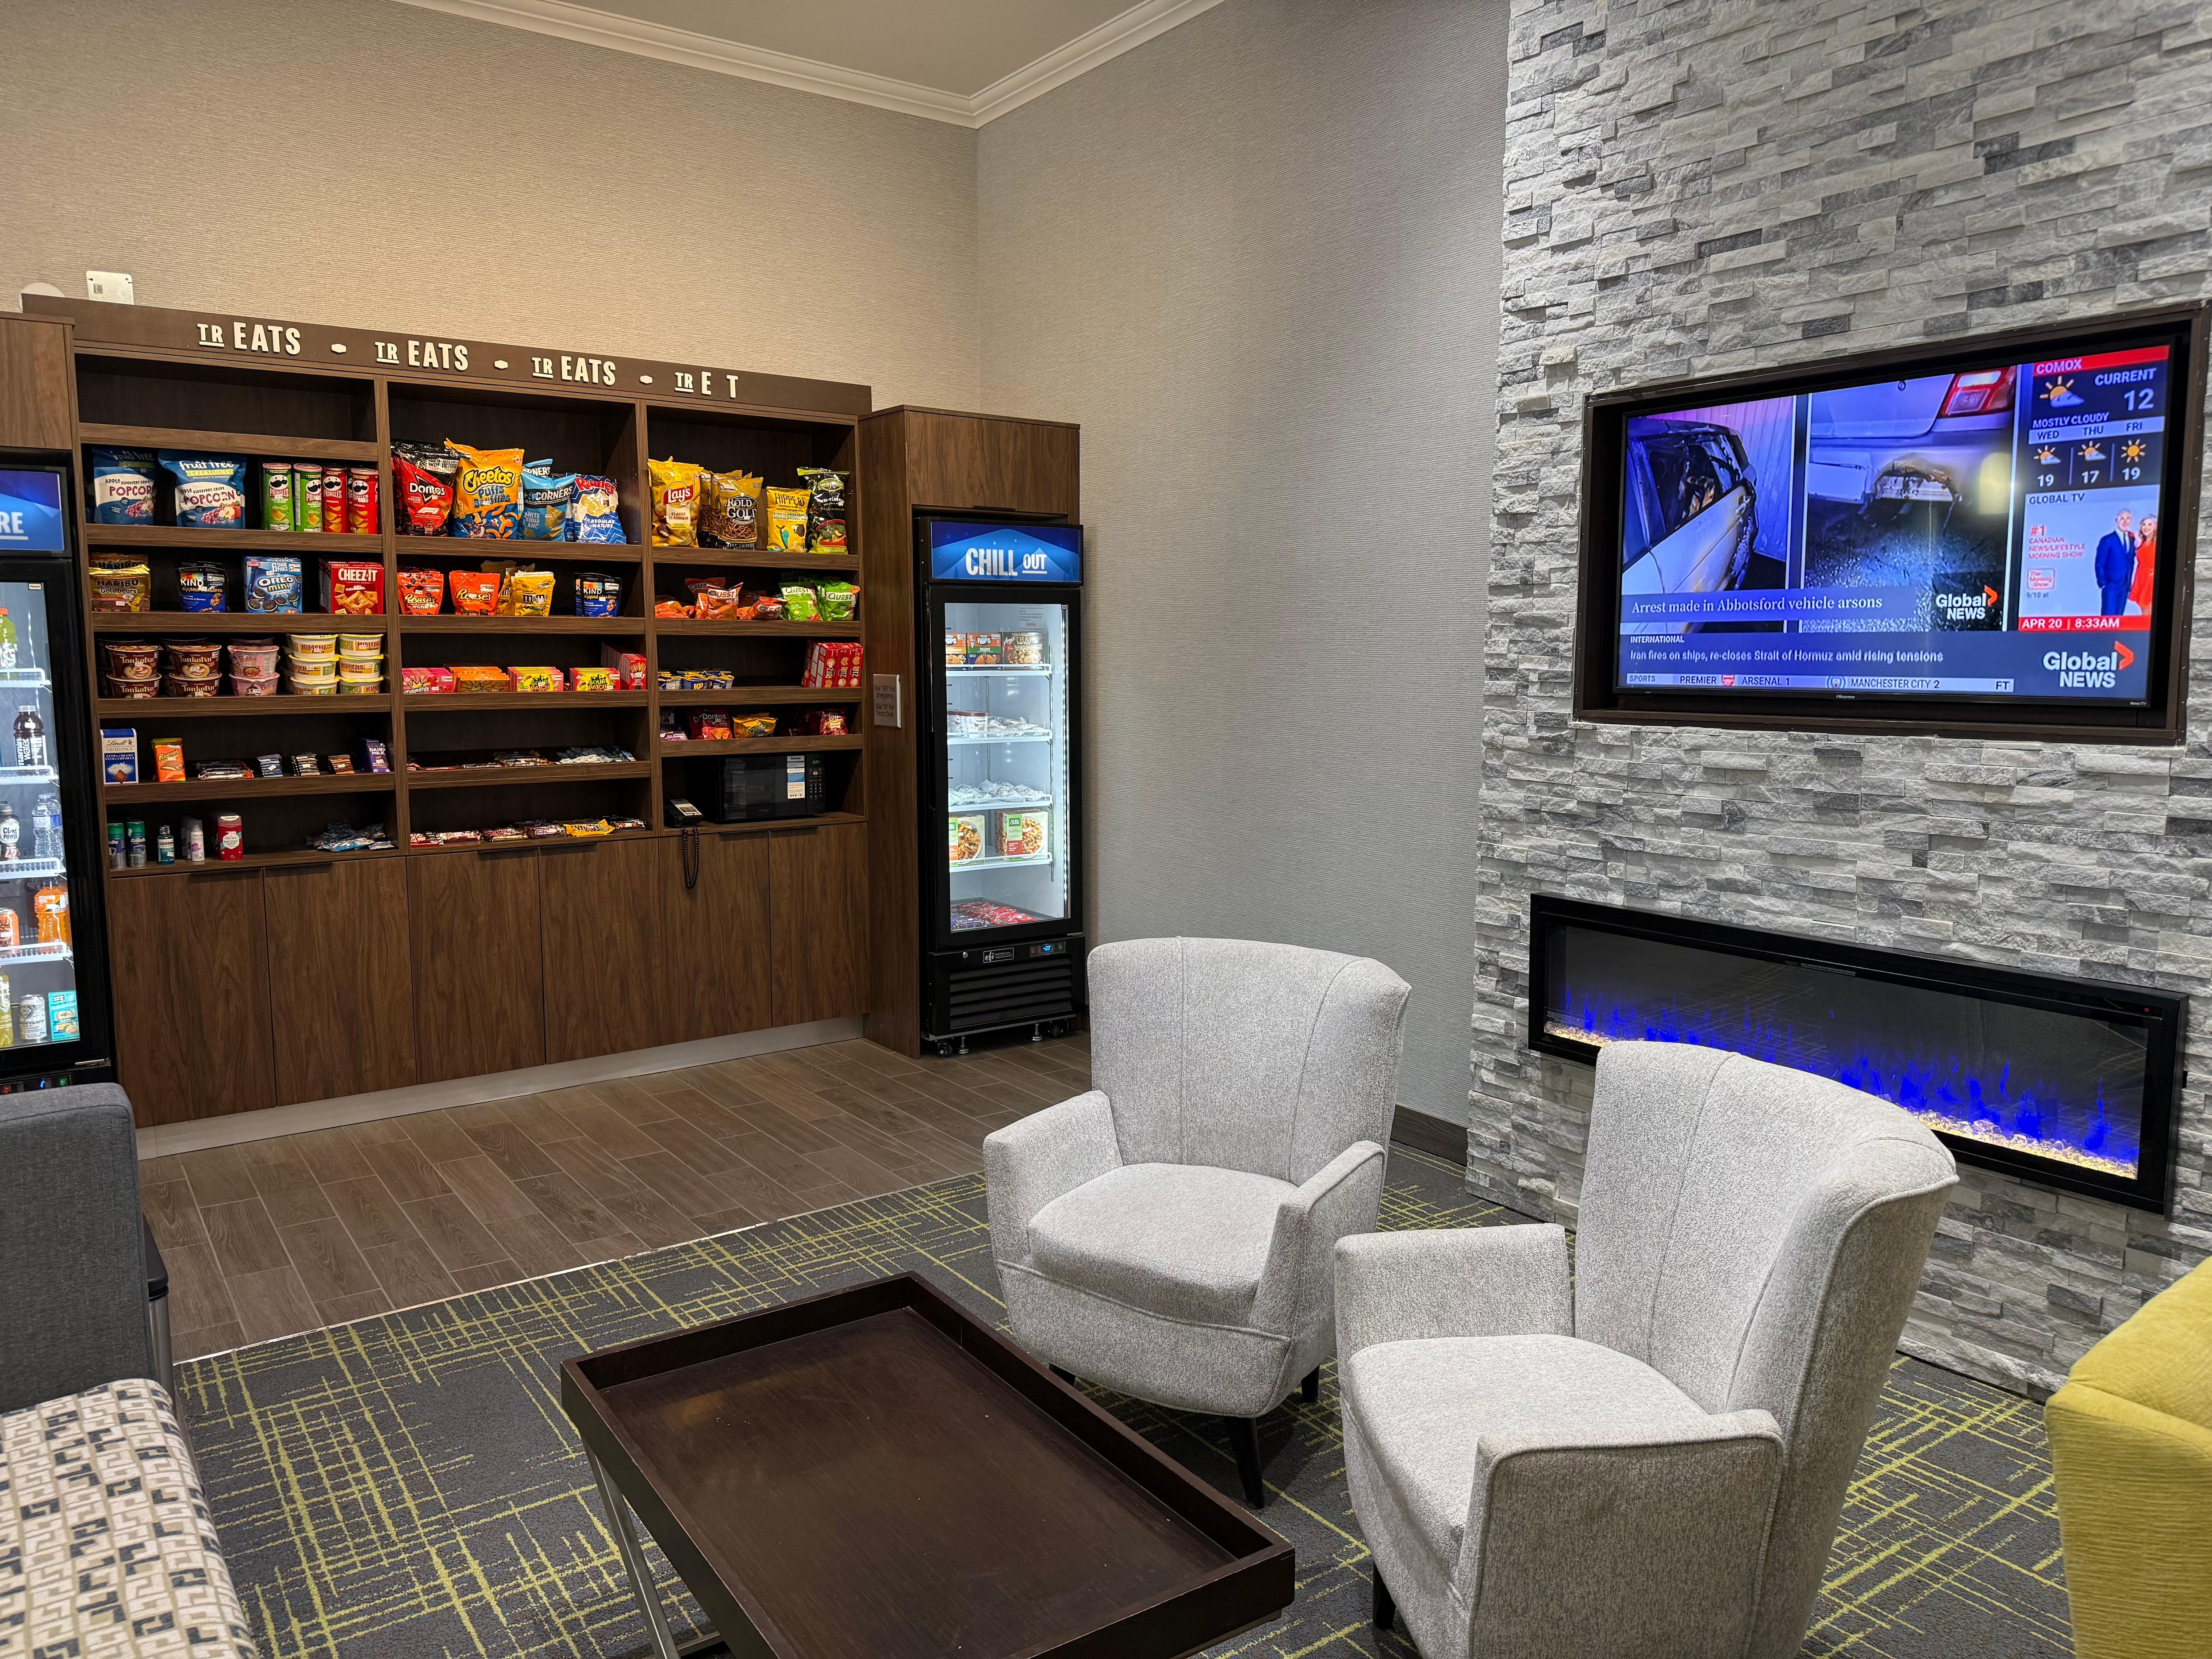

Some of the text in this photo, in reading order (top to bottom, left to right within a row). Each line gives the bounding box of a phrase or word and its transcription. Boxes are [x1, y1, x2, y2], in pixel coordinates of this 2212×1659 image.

[197, 323, 224, 343] TR
[234, 322, 301, 355] EATS
[375, 341, 398, 360] TR
[408, 340, 470, 373] EATS
[532, 357, 553, 373] TR
[561, 355, 616, 385] EATS
[675, 372, 693, 389] TR
[2036, 359, 2082, 374] COMOX
[2095, 368, 2157, 386] CURRENT
[2124, 388, 2154, 411] 12
[2033, 412, 2109, 429] MOSTLY CLOUDY
[2038, 421, 2143, 440] WED THU FRI
[463, 466, 514, 492] Cheetos
[2037, 467, 2141, 487] 19 17 19
[410, 483, 445, 495] Doritos
[668, 486, 692, 503] Lay's
[184, 490, 235, 505] POPCORN
[727, 498, 753, 508] ROLD
[775, 492, 806, 507] HIPPEAS
[2029, 493, 2085, 504] GLOBAL TV
[2030, 525, 2045, 536] #1
[966, 548, 1047, 576] CHILL OUT
[97, 579, 139, 588] HARIBO
[258, 577, 294, 586] OREO
[269, 583, 290, 591] mini
[1632, 596, 1883, 613] Arrest made in Abbotsford vehicle arsons
[1936, 592, 1986, 607] Global
[1947, 607, 1985, 619] NEWS
[2022, 618, 2120, 628] APR 20 8:33AM
[179, 655, 211, 663] Tonkotsu
[1631, 650, 1646, 660] Iran
[1648, 650, 1667, 660] fires
[1682, 650, 1708, 662] ships,
[1710, 650, 1751, 660] re-closes
[1754, 649, 1778, 660] Strait
[1782, 649, 1792, 660] of
[1794, 649, 1833, 661] Hormuz
[1836, 649, 1861, 661] amid
[1864, 651, 1893, 664] rising
[1897, 650, 1943, 662] tensions
[2043, 652, 2117, 671] Global
[1742, 677, 1782, 685] ARSENAL
[1851, 679, 1909, 688] MANCHESTER
[1911, 680, 1931, 688] CITY
[1996, 680, 2010, 690] FT
[2059, 671, 2116, 688] NEWS
[181, 684, 215, 693] Tonkotsu
